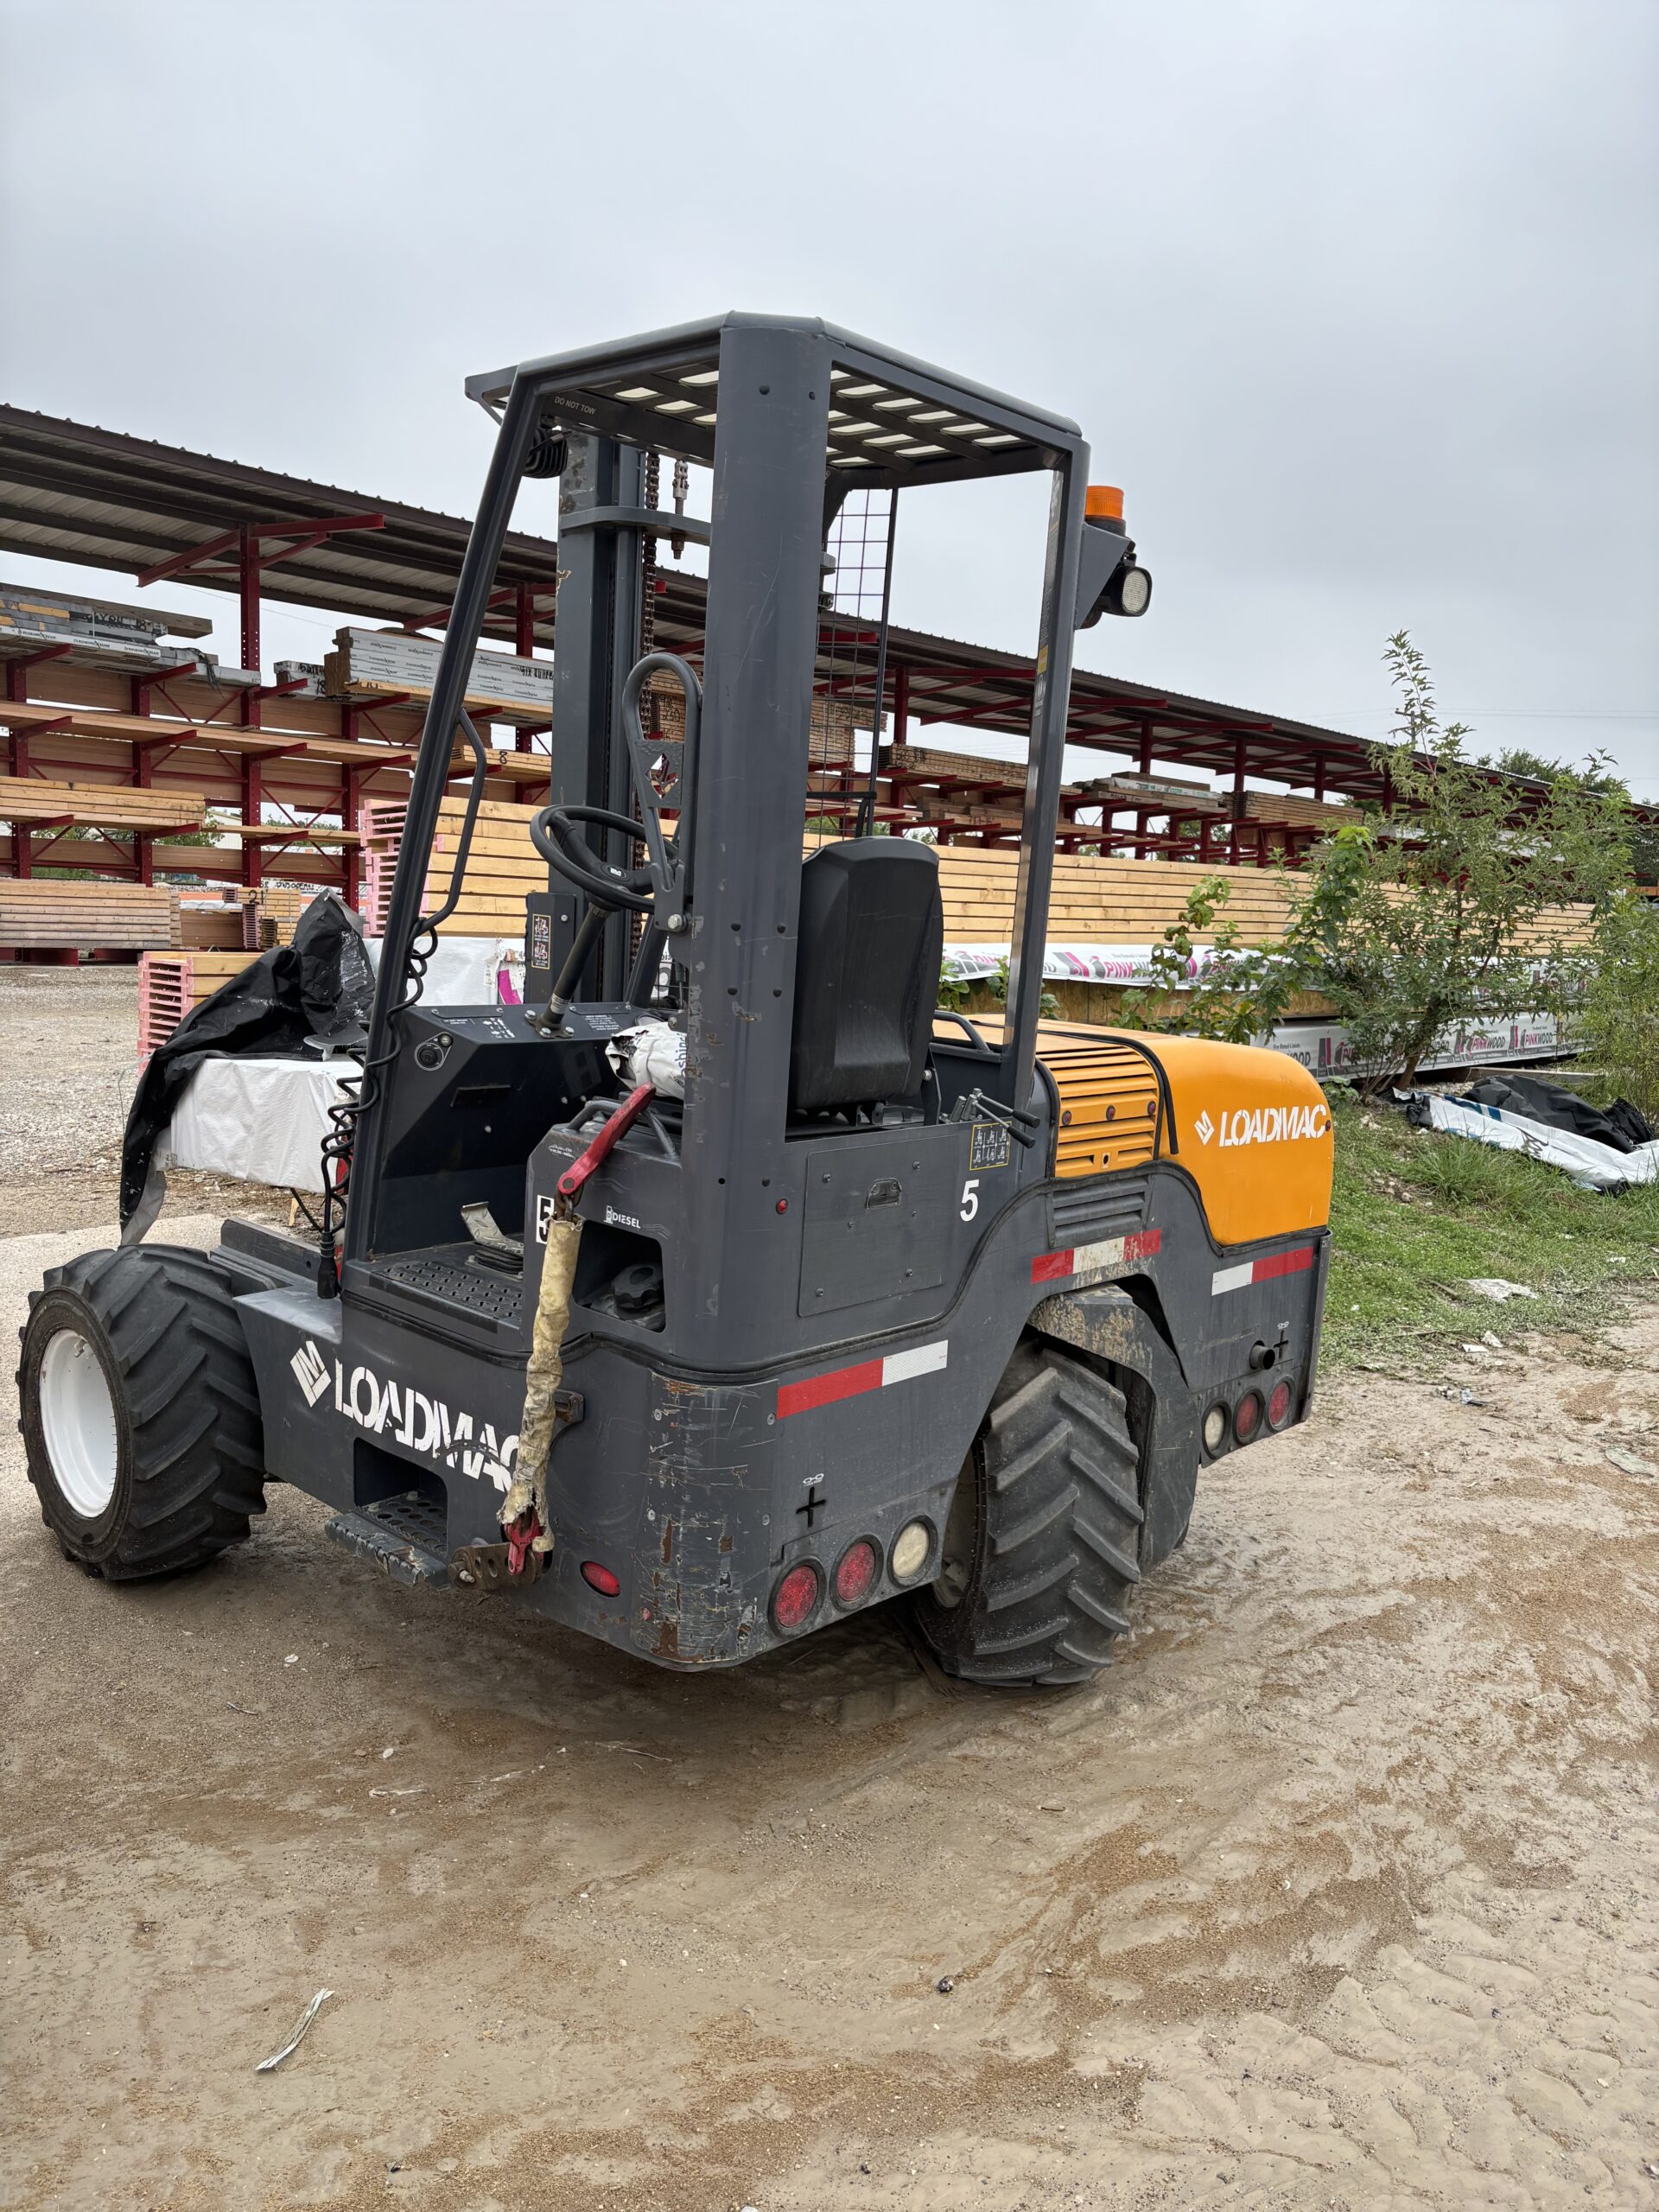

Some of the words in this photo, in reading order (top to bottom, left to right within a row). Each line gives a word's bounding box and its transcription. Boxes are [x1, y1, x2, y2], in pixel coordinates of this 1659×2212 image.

[554, 396, 565, 405] DO
[565, 399, 580, 410] NOT
[581, 404, 596, 415] TOW
[1218, 1103, 1326, 1147] LOADMAC
[538, 1197, 552, 1243] 5
[612, 1213, 641, 1229] DIESEL
[960, 1179, 980, 1222] 5
